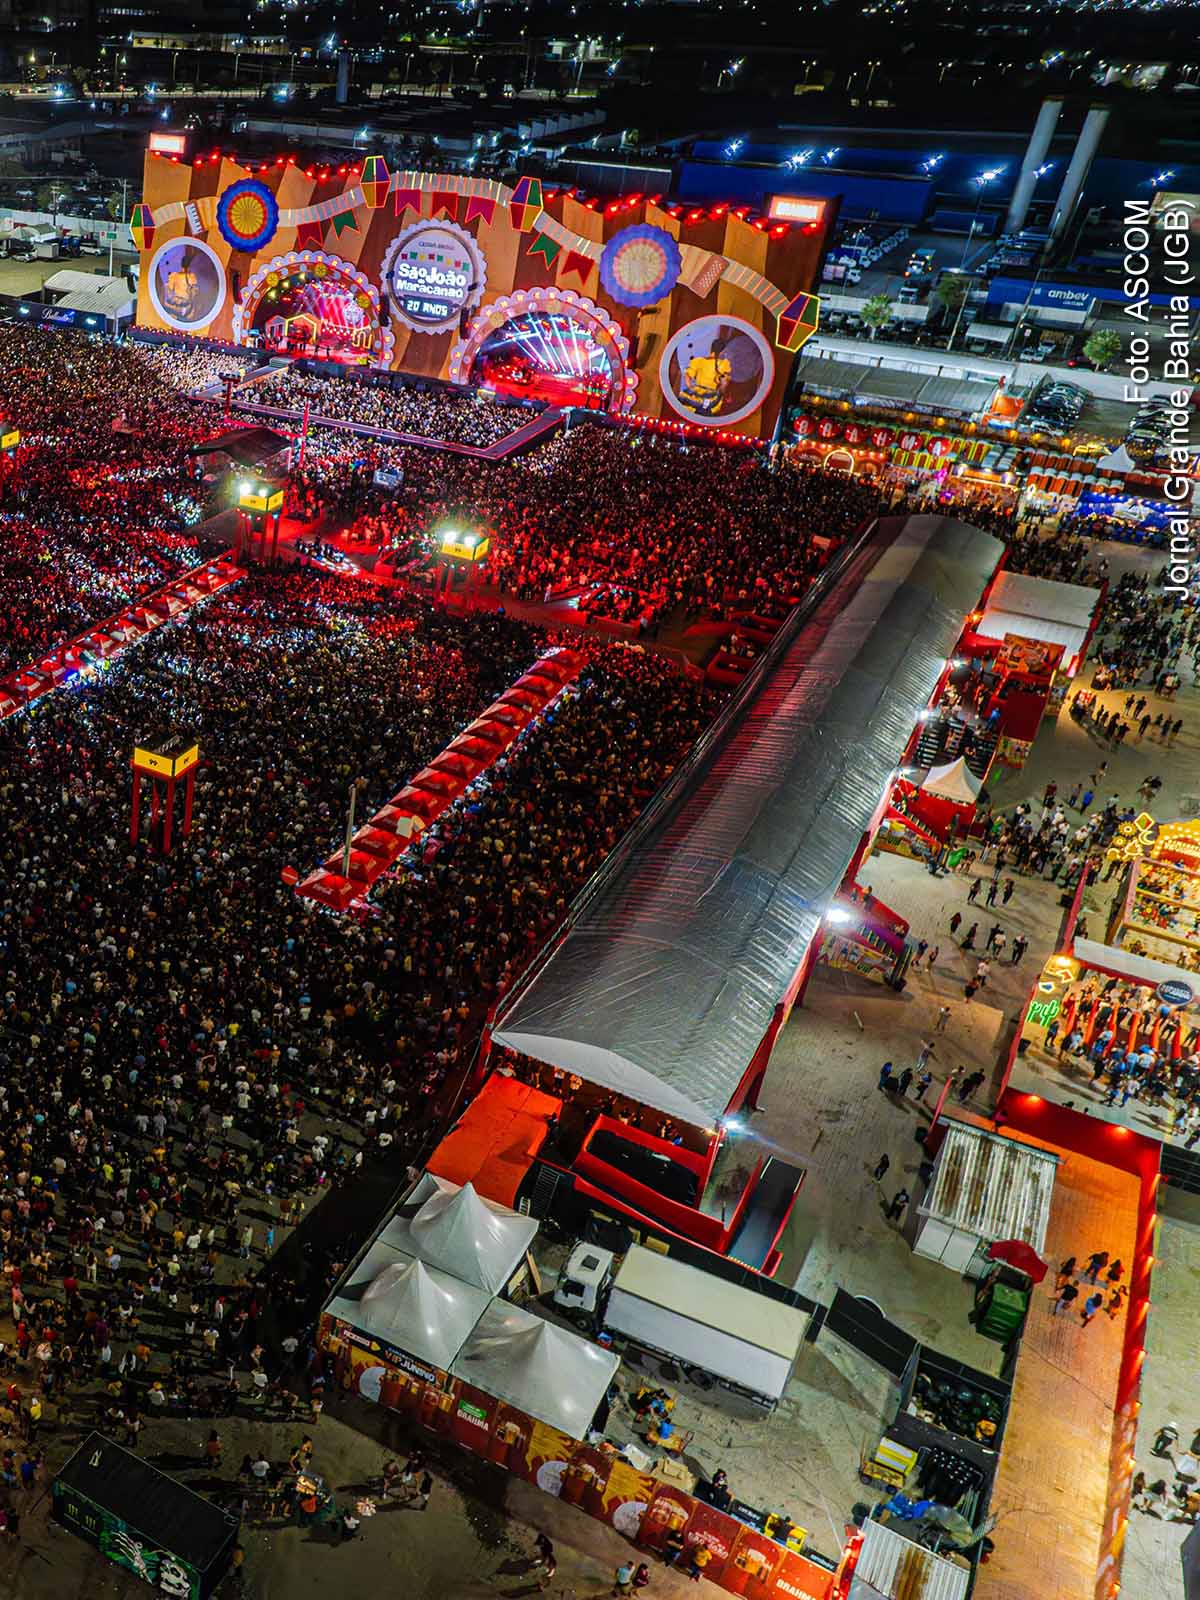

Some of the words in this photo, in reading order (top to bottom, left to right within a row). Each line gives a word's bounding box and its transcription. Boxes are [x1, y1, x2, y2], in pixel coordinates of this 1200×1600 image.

[398, 263, 427, 280] São
[425, 267, 466, 286] João
[1048, 289, 1089, 301] ambev
[406, 300, 419, 312] 20
[422, 302, 448, 316] ANOS
[457, 1409, 489, 1432] BRAHMA
